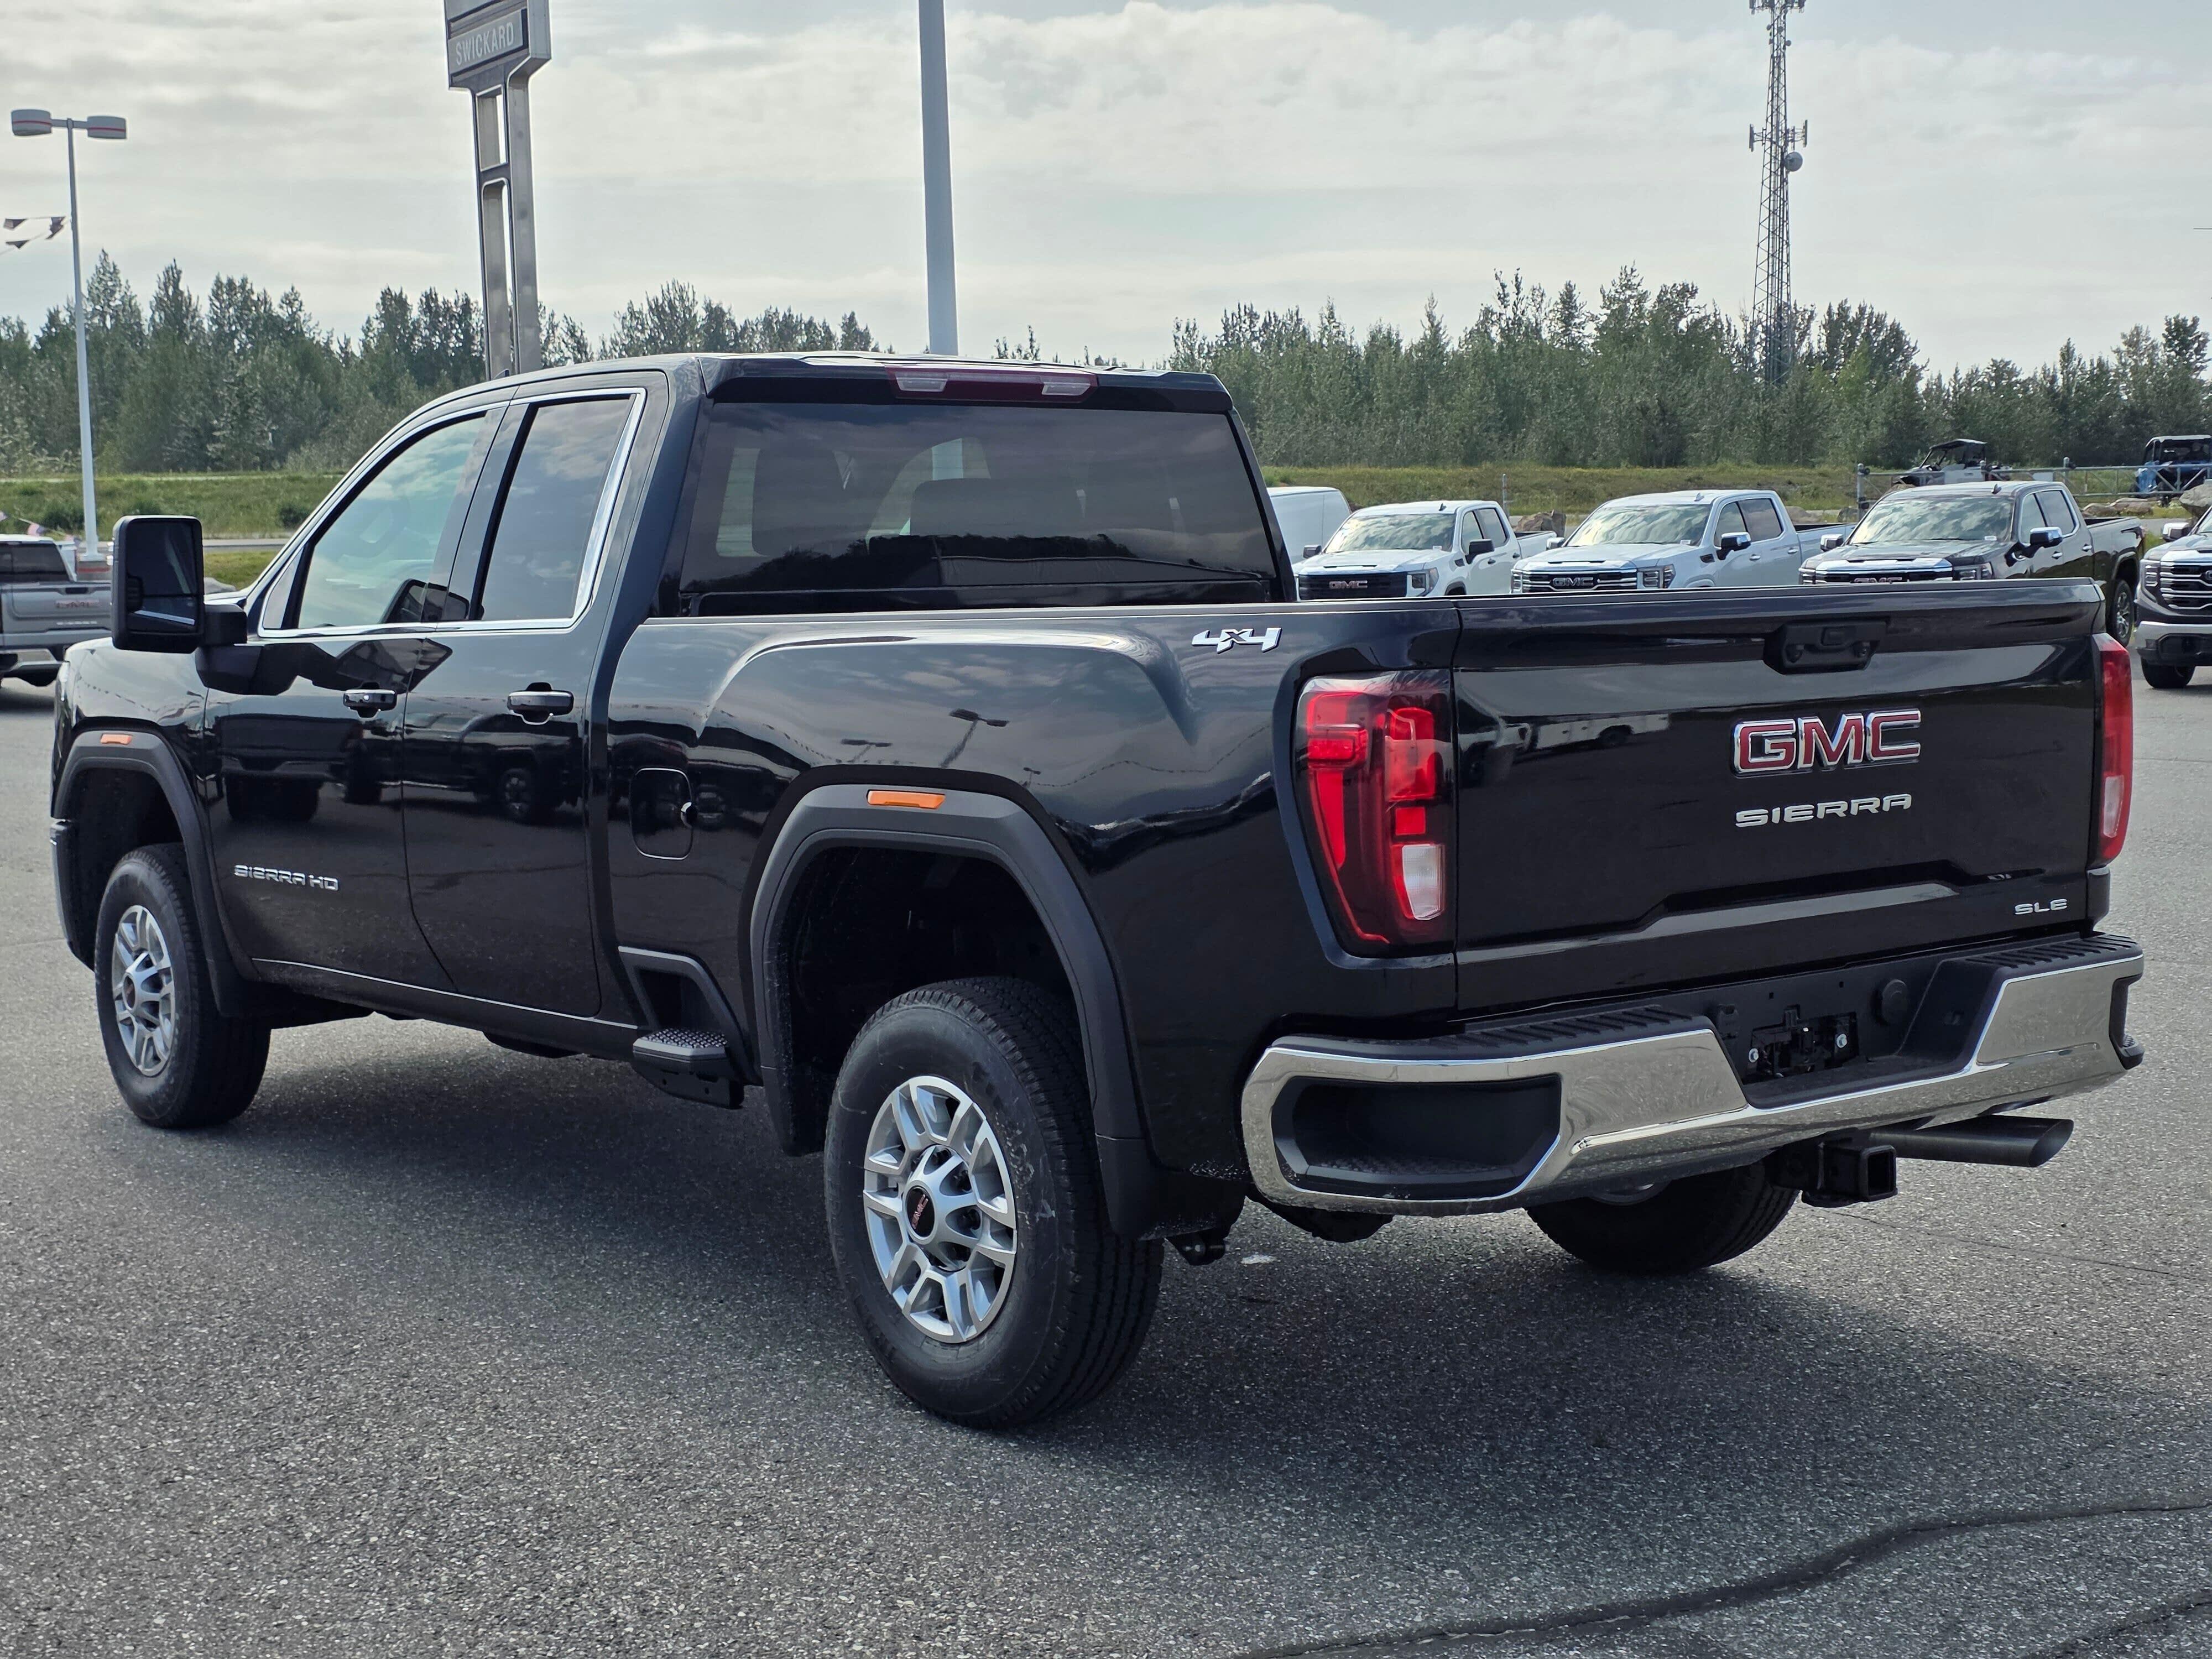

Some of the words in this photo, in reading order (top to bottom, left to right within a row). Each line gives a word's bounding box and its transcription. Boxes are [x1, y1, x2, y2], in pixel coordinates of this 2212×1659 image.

[456, 22, 514, 65] SWICKARD
[1329, 580, 1368, 589] GMC
[1552, 577, 1593, 586] GMC
[1733, 708, 1921, 774] GMC
[1735, 794, 1912, 827] SIERRA
[234, 864, 306, 885] SIERRA
[308, 874, 338, 891] HD
[2015, 899, 2068, 915] SLE
